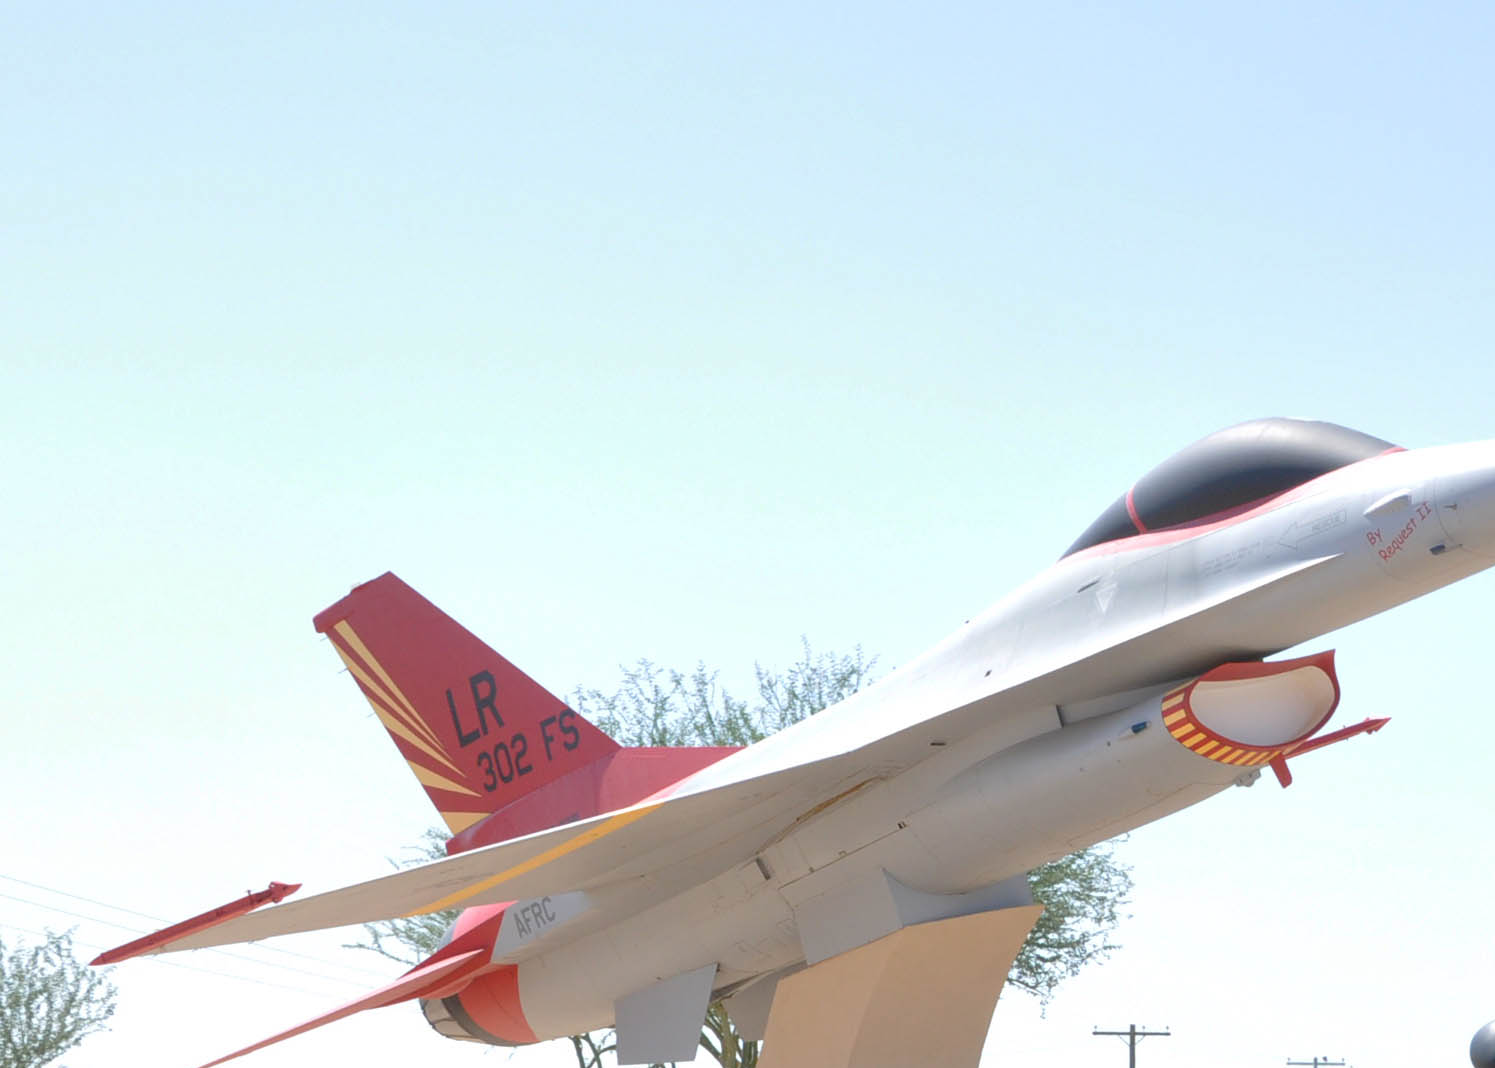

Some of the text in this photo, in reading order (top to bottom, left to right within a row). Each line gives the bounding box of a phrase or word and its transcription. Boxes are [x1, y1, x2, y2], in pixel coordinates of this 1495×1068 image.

[1366, 528, 1383, 545] By
[1378, 518, 1417, 561] Request
[446, 670, 504, 748] LR
[477, 707, 580, 792] 302 FS
[513, 896, 556, 939] AFRC
